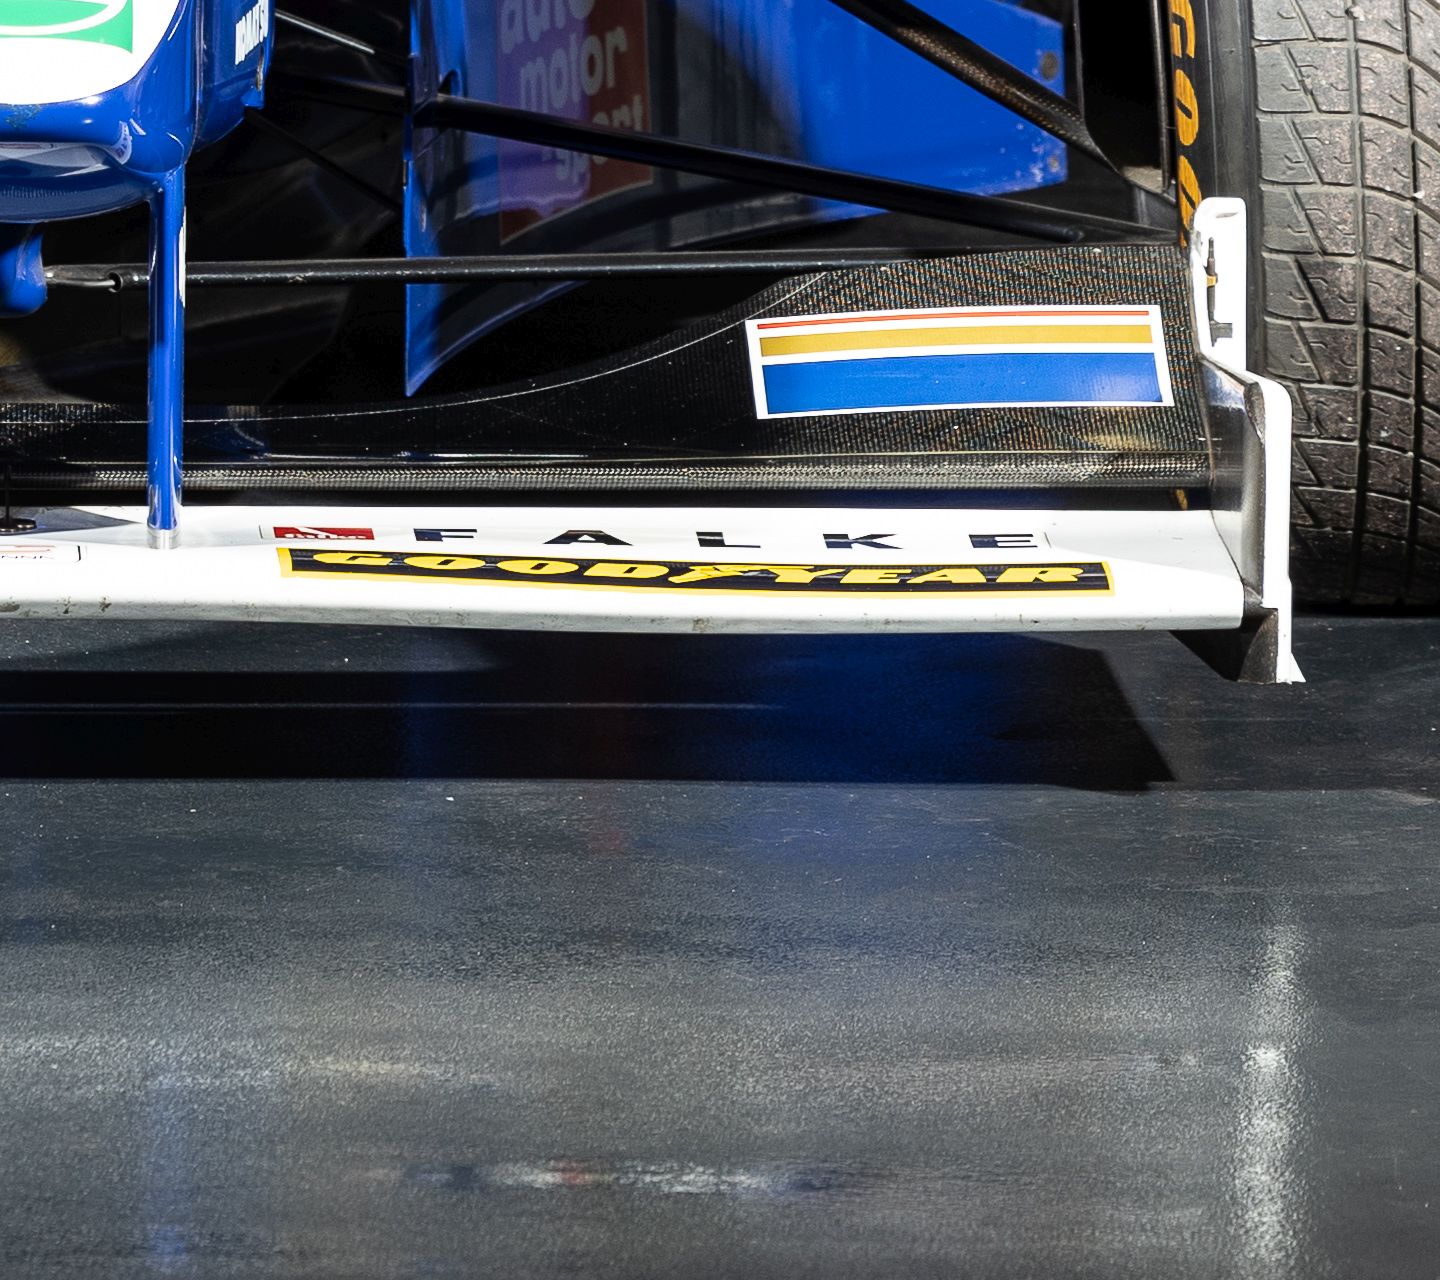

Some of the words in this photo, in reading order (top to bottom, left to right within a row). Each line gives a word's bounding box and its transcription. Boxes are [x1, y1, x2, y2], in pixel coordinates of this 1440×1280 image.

[519, 25, 629, 112] motor
[414, 526, 1040, 550] FALKE
[312, 551, 1083, 585] GOODYEAR
